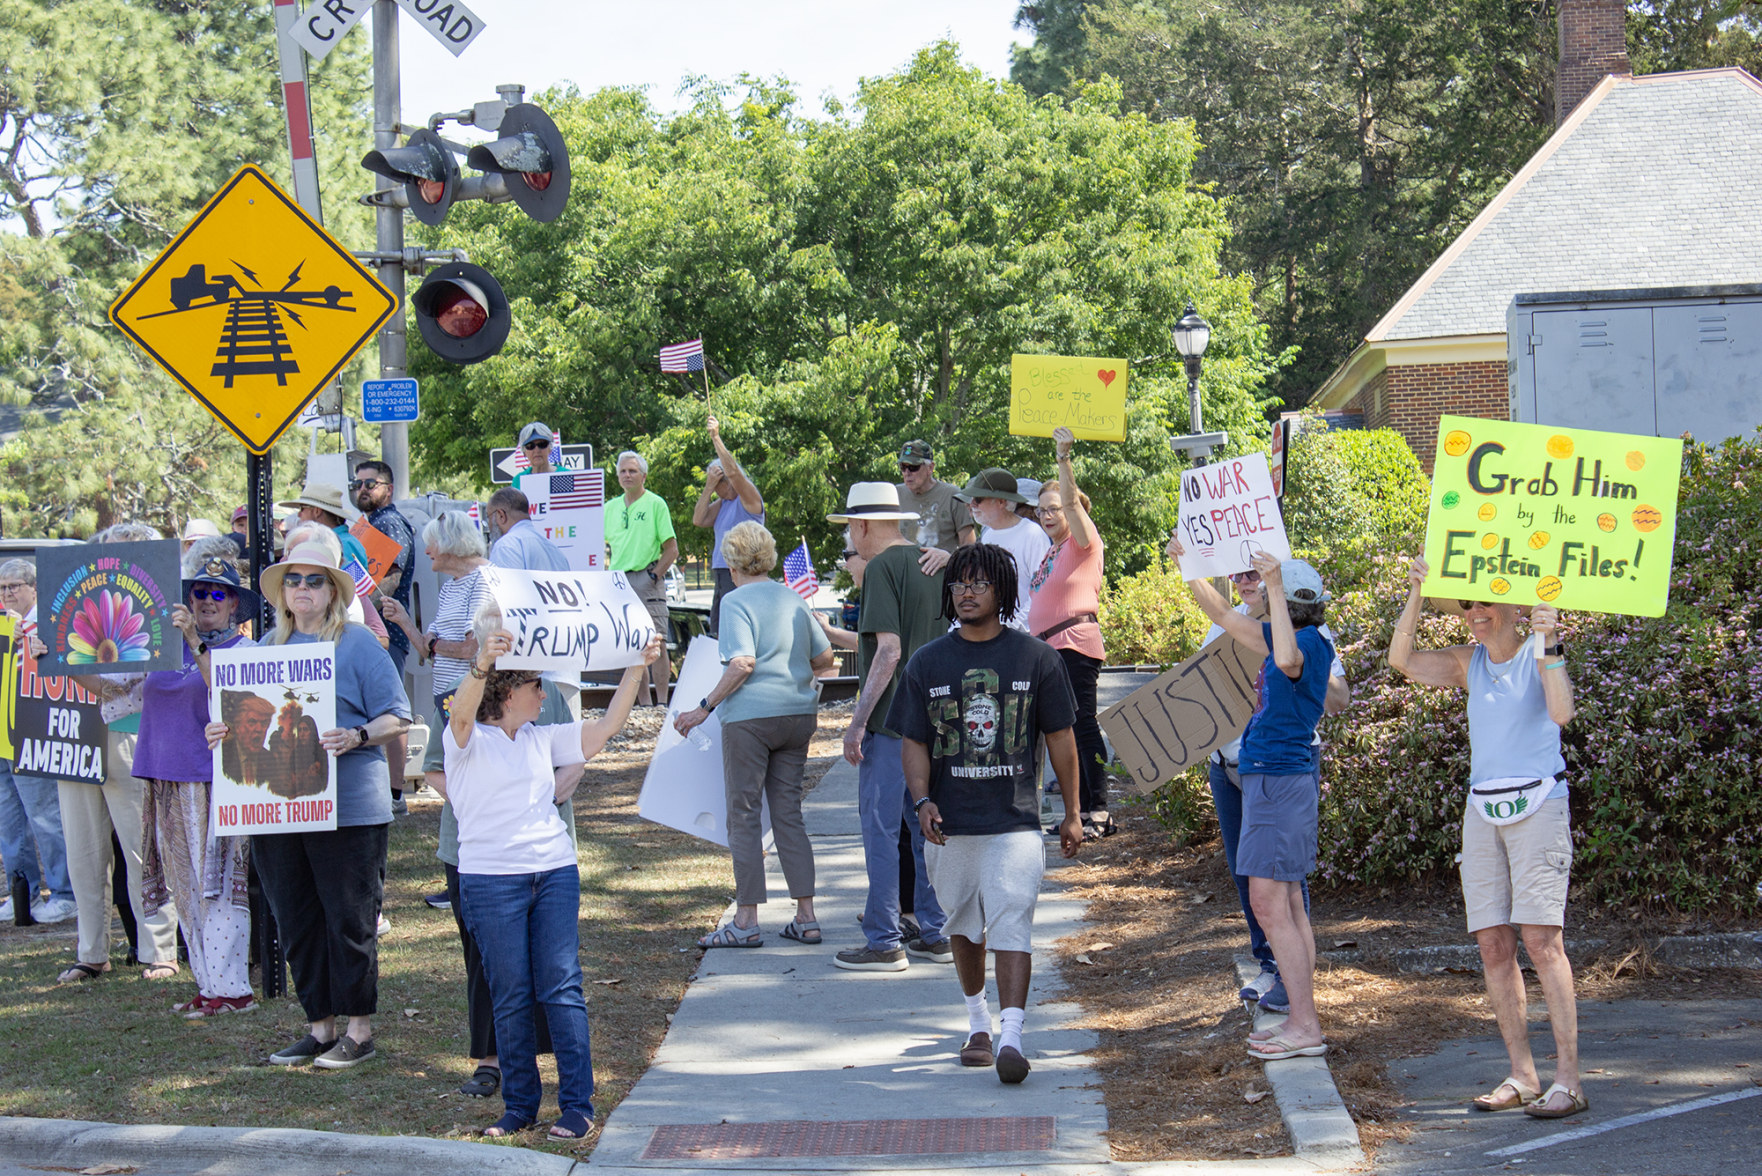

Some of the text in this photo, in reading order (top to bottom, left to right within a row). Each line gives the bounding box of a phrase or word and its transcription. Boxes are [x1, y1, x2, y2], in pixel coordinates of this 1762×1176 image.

[308, 0, 357, 42] CR
[406, 0, 473, 43] OAD
[391, 382, 412, 390] PROBLEM
[1028, 361, 1090, 388] Blessed
[365, 397, 415, 405] 1-800-232-0144
[1047, 388, 1092, 403] are the
[1183, 475, 1201, 502] NO
[1202, 461, 1250, 500] WAR
[1467, 441, 1637, 499] Grab Him
[528, 502, 547, 515] WE
[1181, 495, 1274, 546] YES PEACE
[1517, 503, 1576, 528] by the
[544, 525, 576, 540] THE
[97, 557, 120, 570] HOPE
[1440, 529, 1645, 584] Epstein Files!
[50, 564, 89, 614] INCLUSION
[80, 572, 108, 594] PEACE
[116, 573, 154, 609] EQUALITY
[129, 563, 168, 608] DIVERSITY
[533, 579, 590, 607] NO!
[56, 596, 78, 652] KINDNESS
[150, 618, 162, 646] LOVE
[506, 601, 656, 669] TRUMP War
[216, 657, 332, 687] NO MORE WARS
[929, 681, 1031, 698] STONE COLD
[48, 707, 81, 739] FOR
[1110, 638, 1257, 782] JUSTIC
[18, 738, 103, 780] AMERICA
[951, 765, 1014, 778] UNIVERSITY
[218, 800, 333, 826] NO MORE TRUMP
